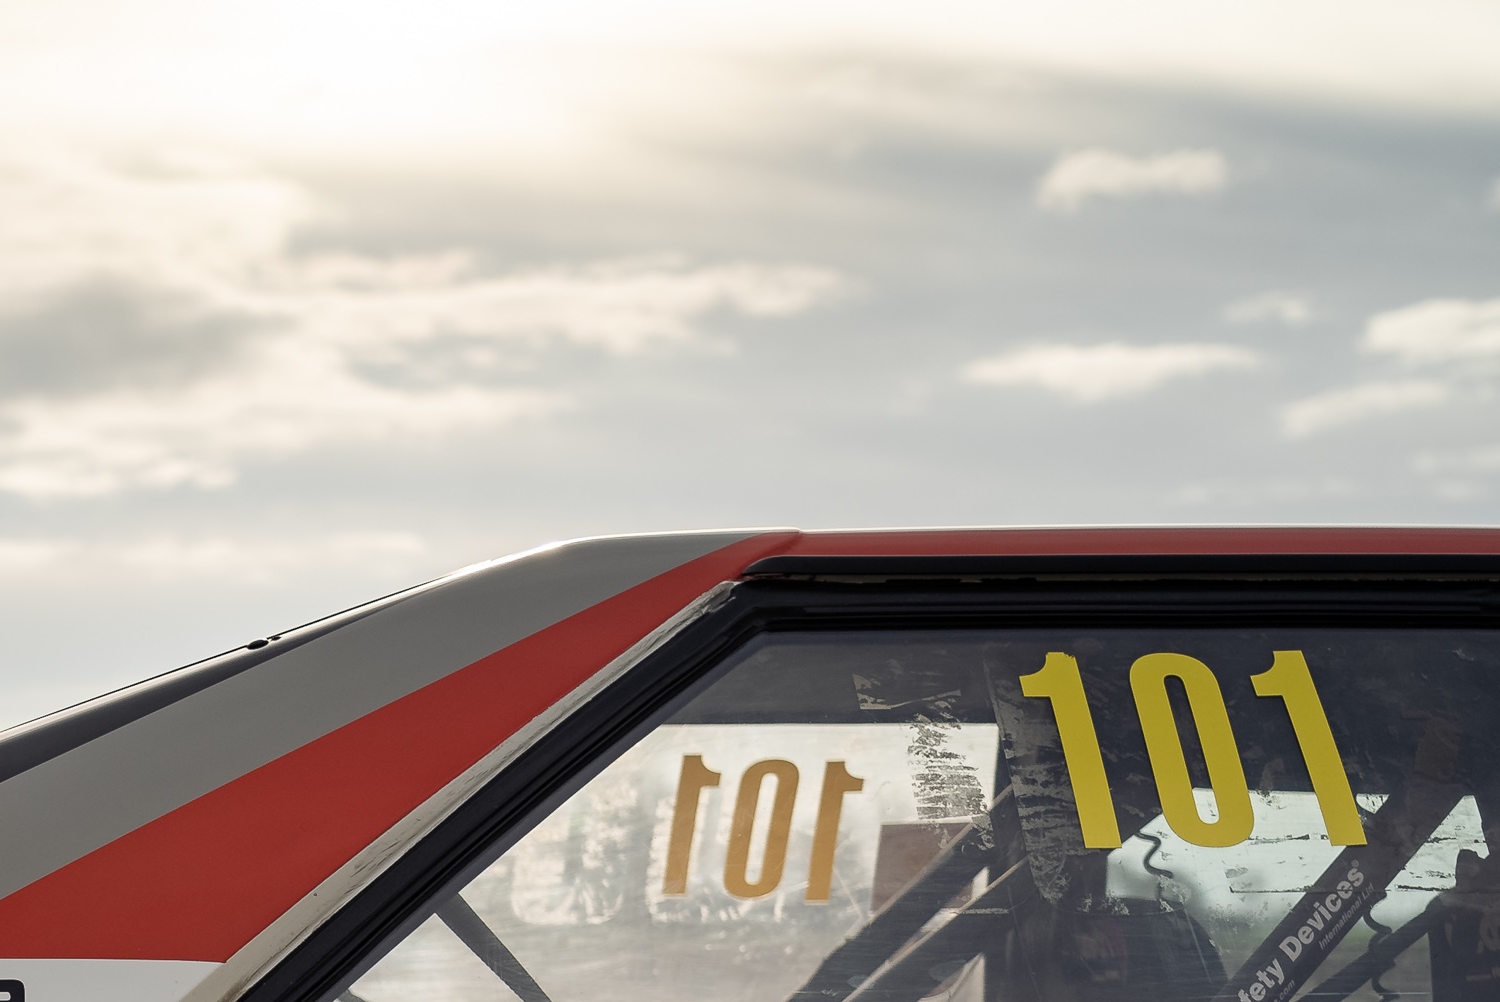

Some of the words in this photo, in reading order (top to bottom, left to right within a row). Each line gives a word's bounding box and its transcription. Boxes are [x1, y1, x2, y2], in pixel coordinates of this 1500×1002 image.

[1019, 650, 1367, 848] 101
[1278, 866, 1365, 963] Devices
[1318, 895, 1363, 951] International
